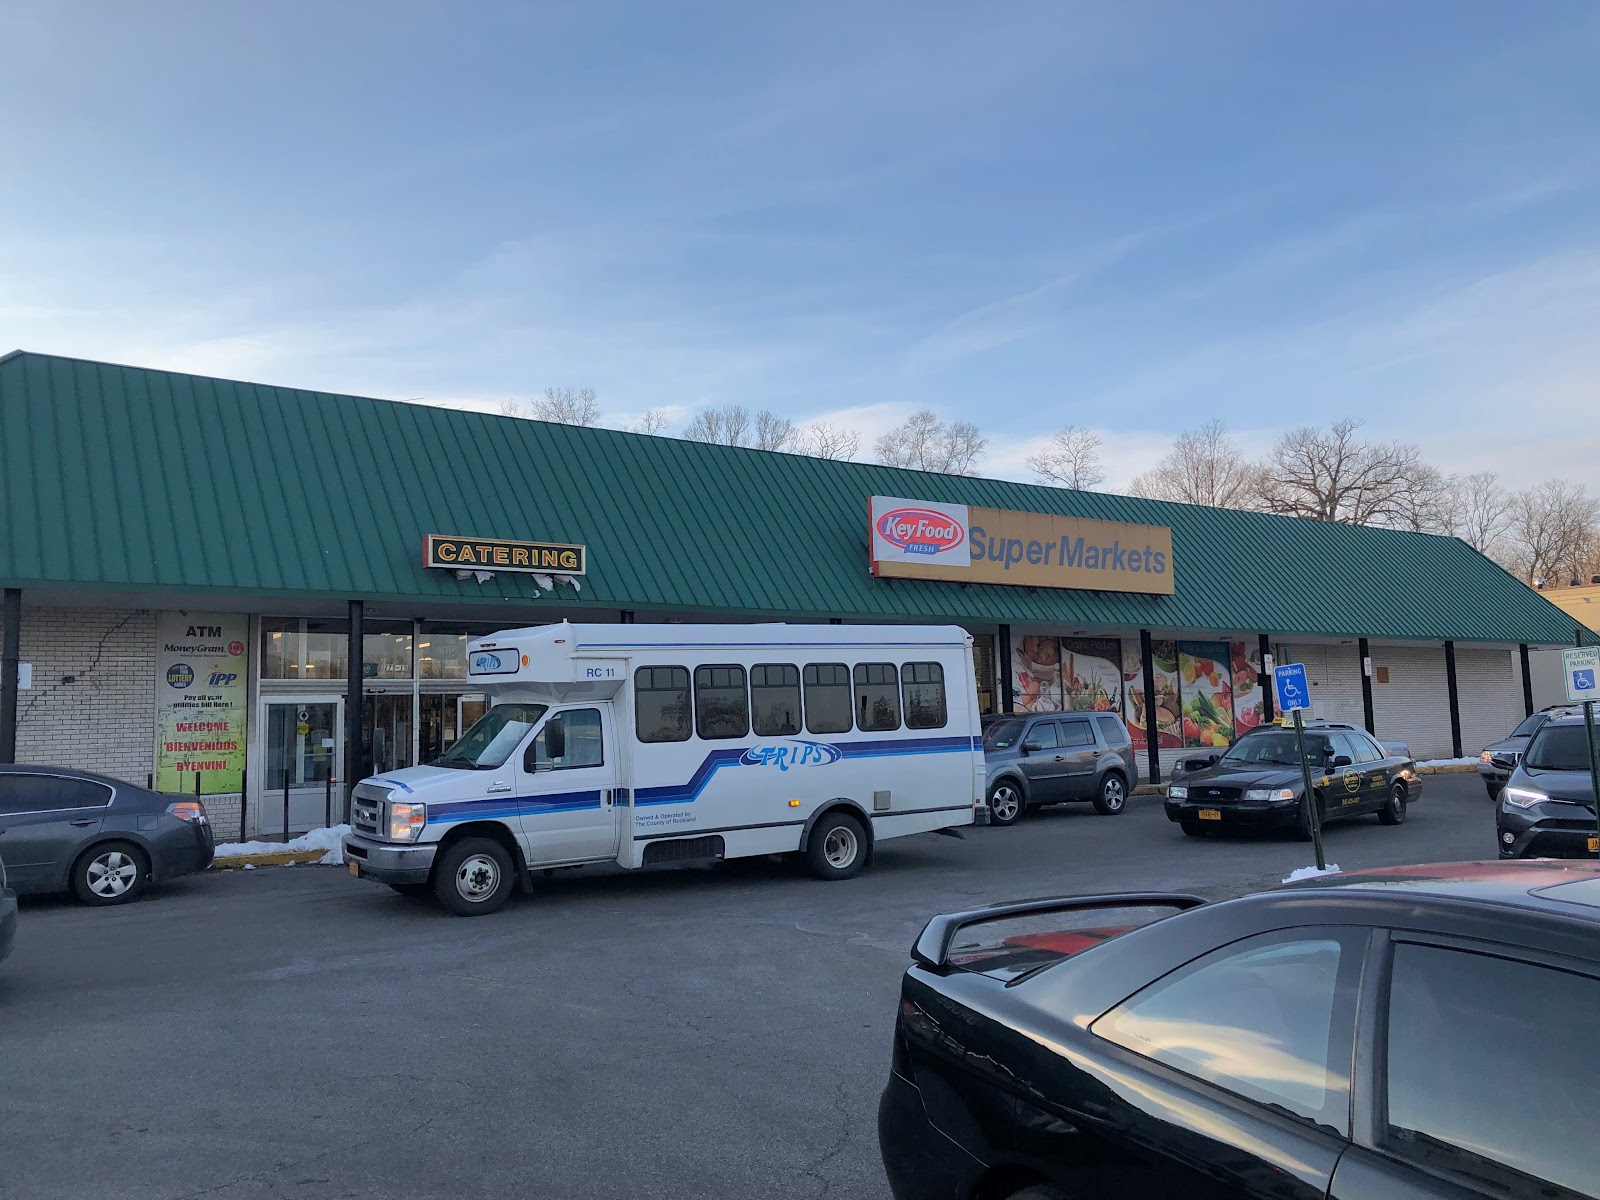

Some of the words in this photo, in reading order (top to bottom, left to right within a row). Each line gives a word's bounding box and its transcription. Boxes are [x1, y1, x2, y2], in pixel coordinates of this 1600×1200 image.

[908, 544, 935, 553] FRESH
[437, 543, 577, 568] CATERING
[185, 625, 222, 637] ATM
[163, 643, 225, 654] MoneyGram
[1565, 650, 1598, 660] RESERVED
[1569, 659, 1596, 668] PARKING
[586, 668, 602, 678] RC
[605, 668, 615, 677] 11
[1278, 668, 1302, 678] PARKING
[168, 674, 193, 683] LOTTERY
[1287, 698, 1302, 707] ONLY
[175, 722, 230, 732] WELCOME
[165, 741, 238, 752] BIENVENIDOS
[758, 743, 823, 772] TRIPS
[635, 814, 654, 822] Owned
[660, 811, 684, 820] Operated
[646, 819, 665, 827] County
[672, 816, 697, 825] Rockland
